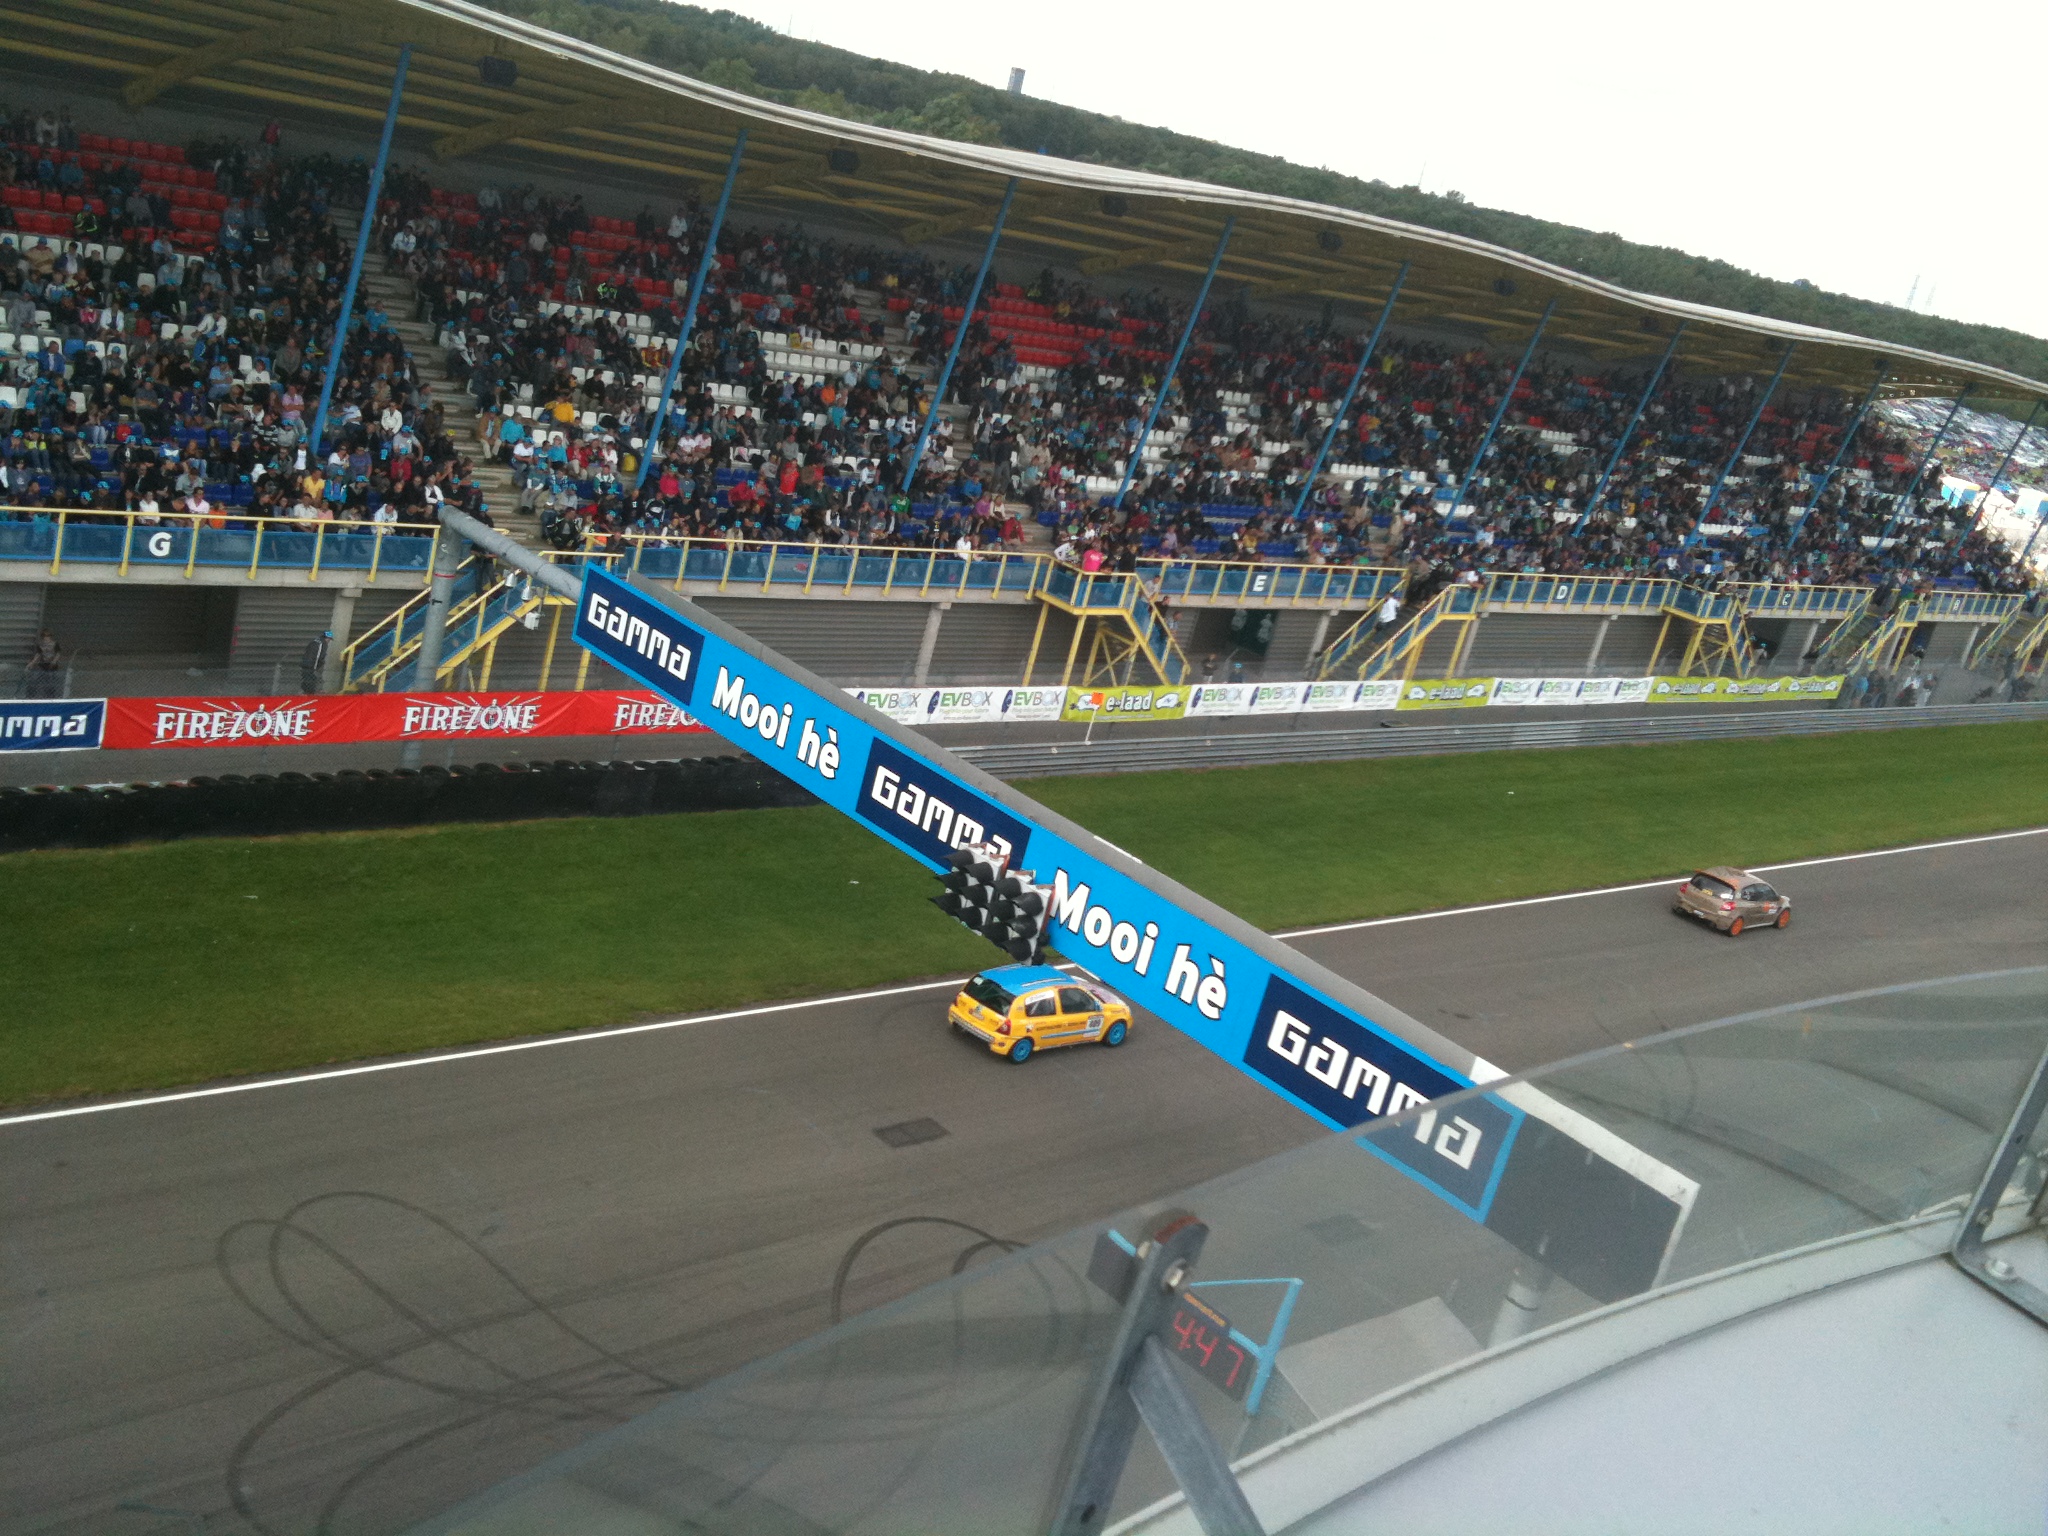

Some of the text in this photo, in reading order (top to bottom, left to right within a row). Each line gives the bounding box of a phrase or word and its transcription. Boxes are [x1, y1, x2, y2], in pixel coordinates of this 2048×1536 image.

[149, 531, 173, 557] G
[1253, 574, 1268, 592] E
[1556, 585, 1568, 600] D
[1106, 689, 1154, 713] e-laad
[155, 708, 312, 739] FIREZONE
[403, 704, 541, 732] FIREZONE
[711, 665, 840, 779] Mooi hè
[1049, 867, 1228, 1020] Mooi hè
